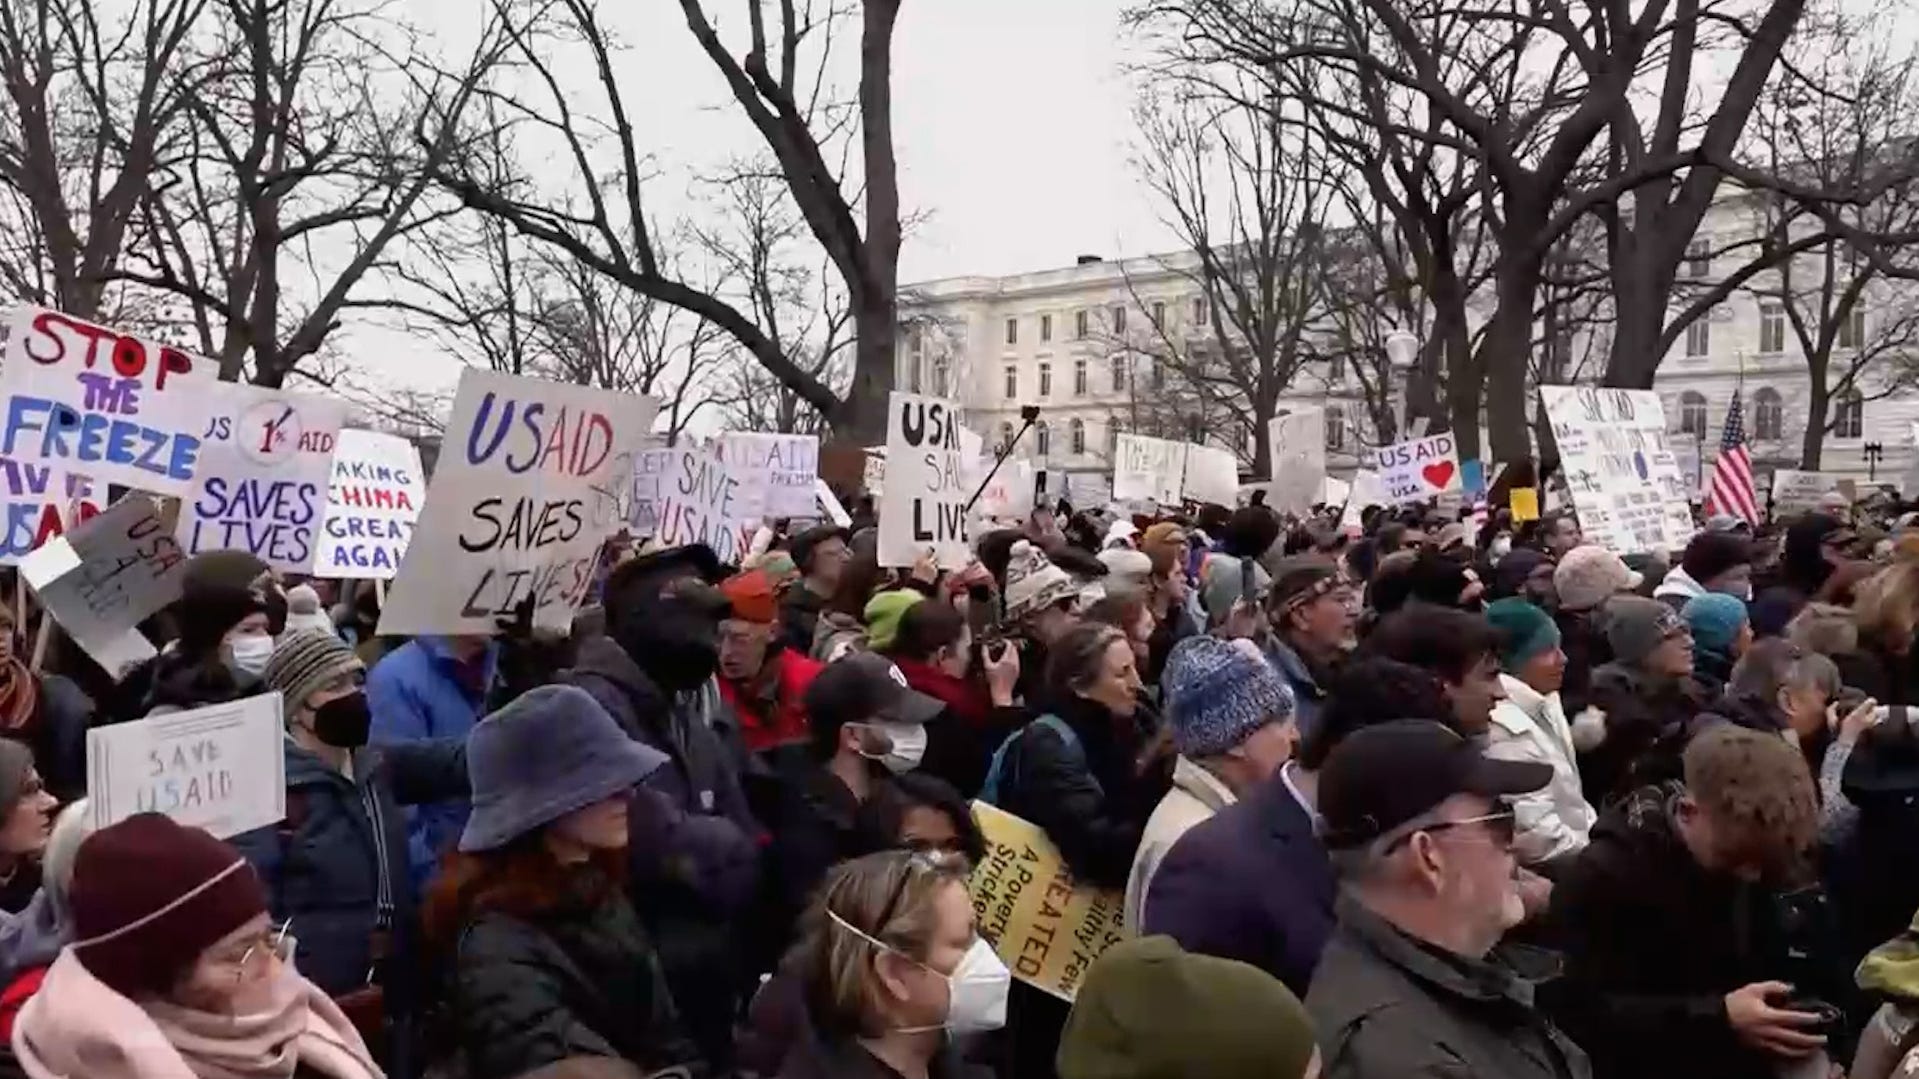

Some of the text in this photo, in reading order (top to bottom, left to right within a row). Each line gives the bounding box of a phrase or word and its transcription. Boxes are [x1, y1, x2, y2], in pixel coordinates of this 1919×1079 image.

[24, 313, 192, 391] STOP
[77, 372, 142, 415] THE
[2, 396, 201, 481] FREEZE
[299, 431, 334, 453] AID
[467, 391, 614, 477] USAID
[1416, 437, 1451, 462] AID
[0, 457, 95, 498] AVE
[336, 461, 411, 485] AKING
[678, 451, 740, 519] SAVE
[195, 477, 317, 525] SAVES
[914, 498, 969, 542] LIVE
[459, 496, 583, 552] SAVES
[334, 545, 400, 569] AGAI
[150, 739, 221, 777] SAVE
[136, 769, 234, 814] USAID
[1020, 845, 1039, 863] A
[974, 843, 1017, 922] Stricke
[1016, 868, 1075, 978] REATED
